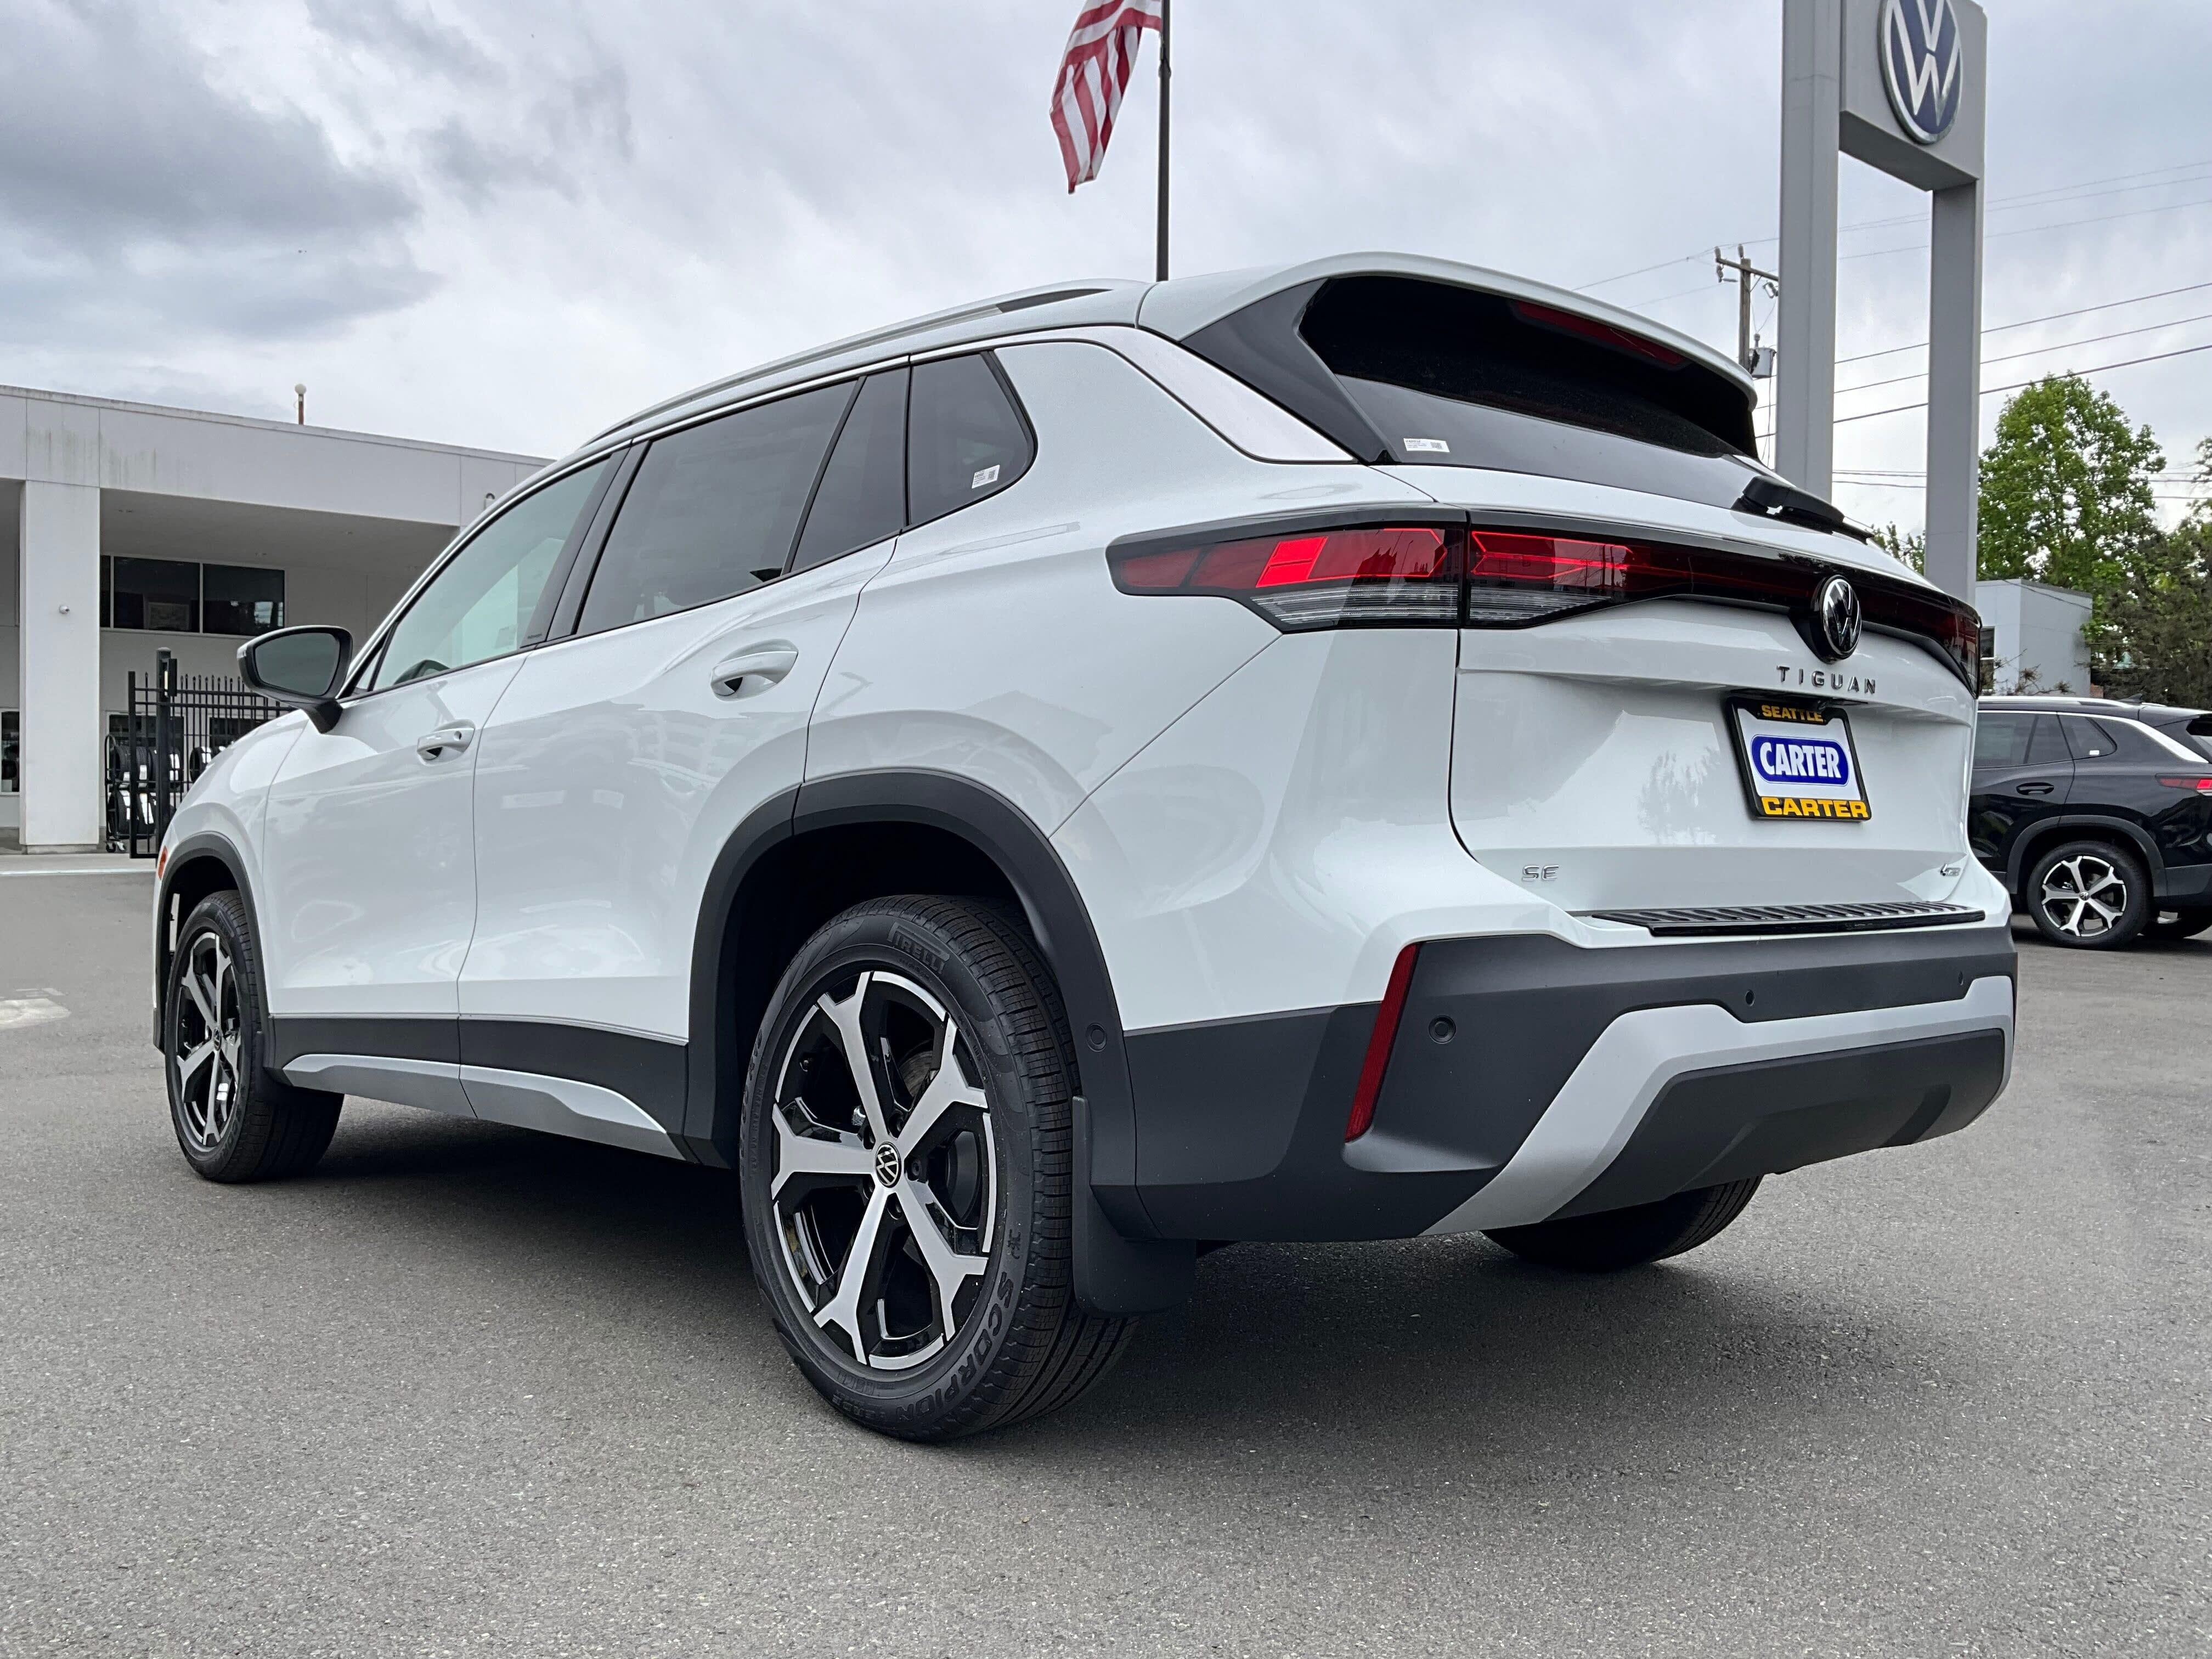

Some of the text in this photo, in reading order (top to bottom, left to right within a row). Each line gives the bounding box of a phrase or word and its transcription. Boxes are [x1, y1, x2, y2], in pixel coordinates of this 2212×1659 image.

[1776, 665, 1876, 695] TIGUAN
[1761, 704, 1824, 723] SEATTLE
[1759, 742, 1842, 778] CARTER
[1761, 797, 1868, 819] CARTER
[1522, 865, 1559, 881] SE
[887, 921, 950, 975] PIRELLI
[895, 1271, 1014, 1421] SCORPION
